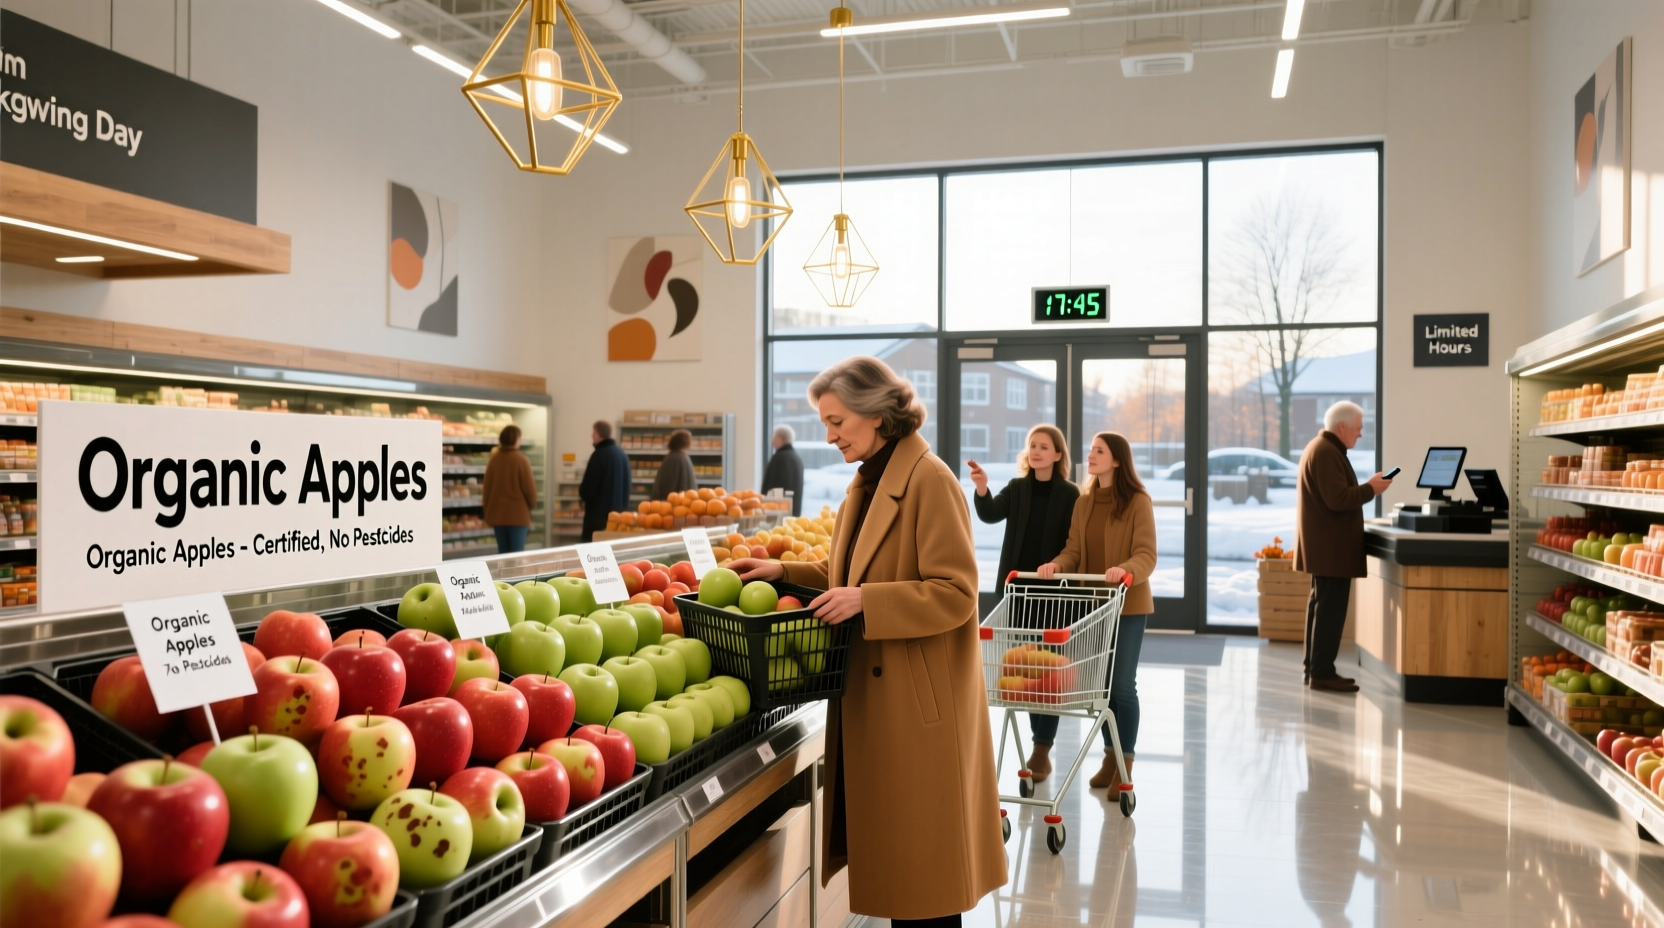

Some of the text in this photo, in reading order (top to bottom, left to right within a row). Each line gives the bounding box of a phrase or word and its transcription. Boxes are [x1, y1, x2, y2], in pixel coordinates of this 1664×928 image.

[96, 109, 143, 157] Day
[1046, 292, 1100, 316] 17:45
[1425, 323, 1479, 339] Limited
[1429, 341, 1472, 355] Hours
[78, 436, 428, 528] Organic Apples
[86, 540, 167, 574] Organic
[173, 536, 235, 568] Apples
[253, 528, 325, 556] Certified,
[329, 528, 350, 549] No
[151, 610, 211, 633] Organic
[166, 633, 216, 657] Apples
